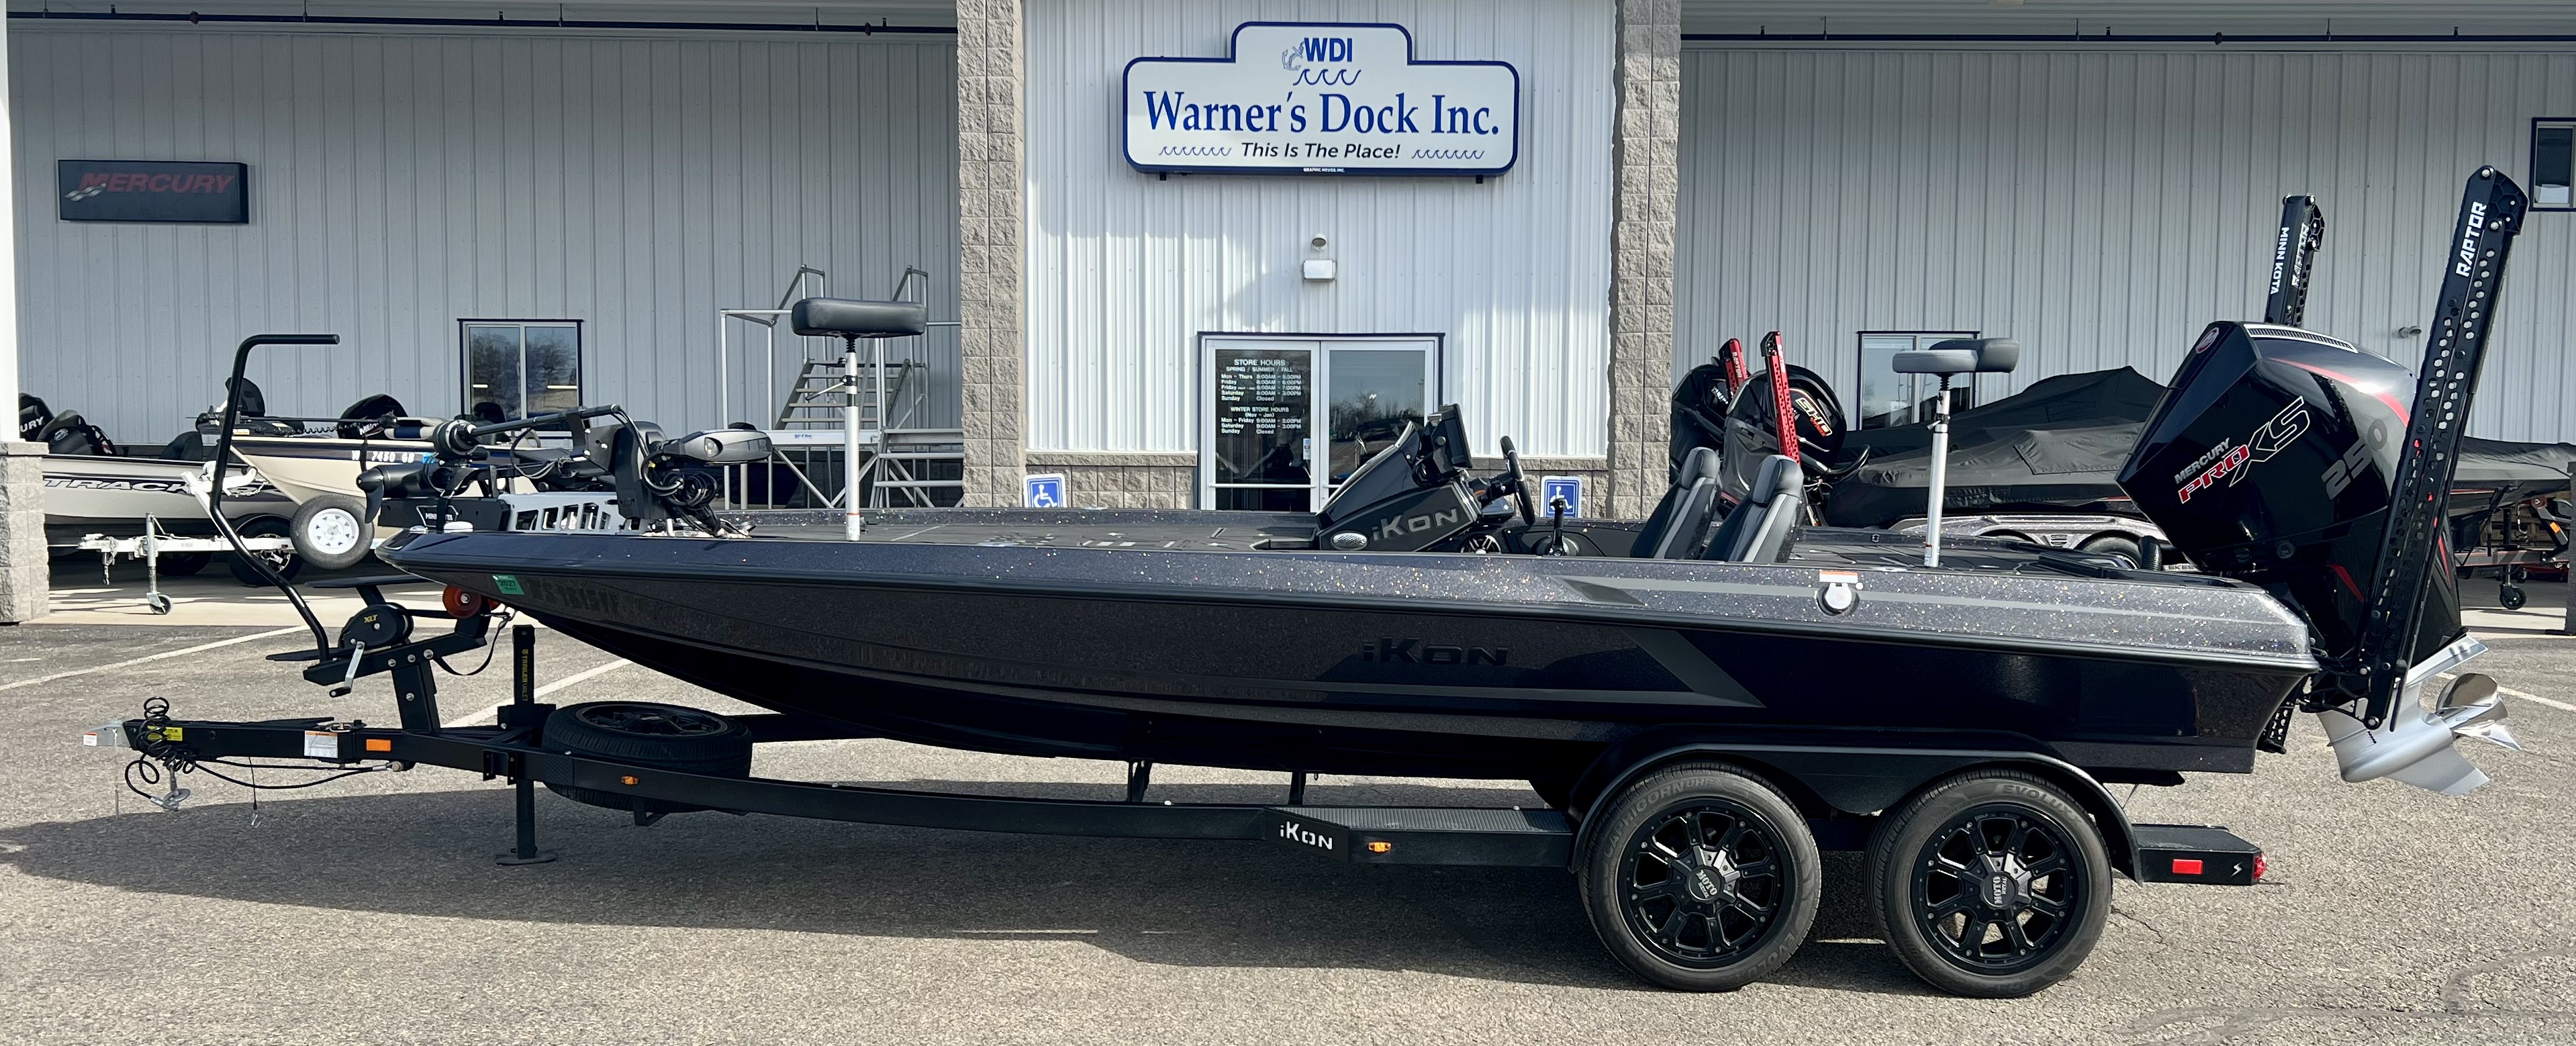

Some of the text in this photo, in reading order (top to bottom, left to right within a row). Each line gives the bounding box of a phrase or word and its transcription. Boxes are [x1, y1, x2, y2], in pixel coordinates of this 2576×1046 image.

[1304, 38, 1353, 62] WDI
[1143, 91, 1499, 134] Warner's Dock Inc.
[1241, 142, 1400, 160] This Is The Place!
[78, 173, 236, 193] MERCURY
[2291, 223, 2309, 287] RAPTOR
[2456, 201, 2487, 277] RAPTOR
[2270, 227, 2290, 295] MINN KOTA
[2175, 437, 2230, 483] MERCURY
[2321, 418, 2388, 501] 250
[364, 614, 378, 624] XLT
[1696, 870, 1718, 896] MOTO
[1993, 876, 2003, 905] MOTO
